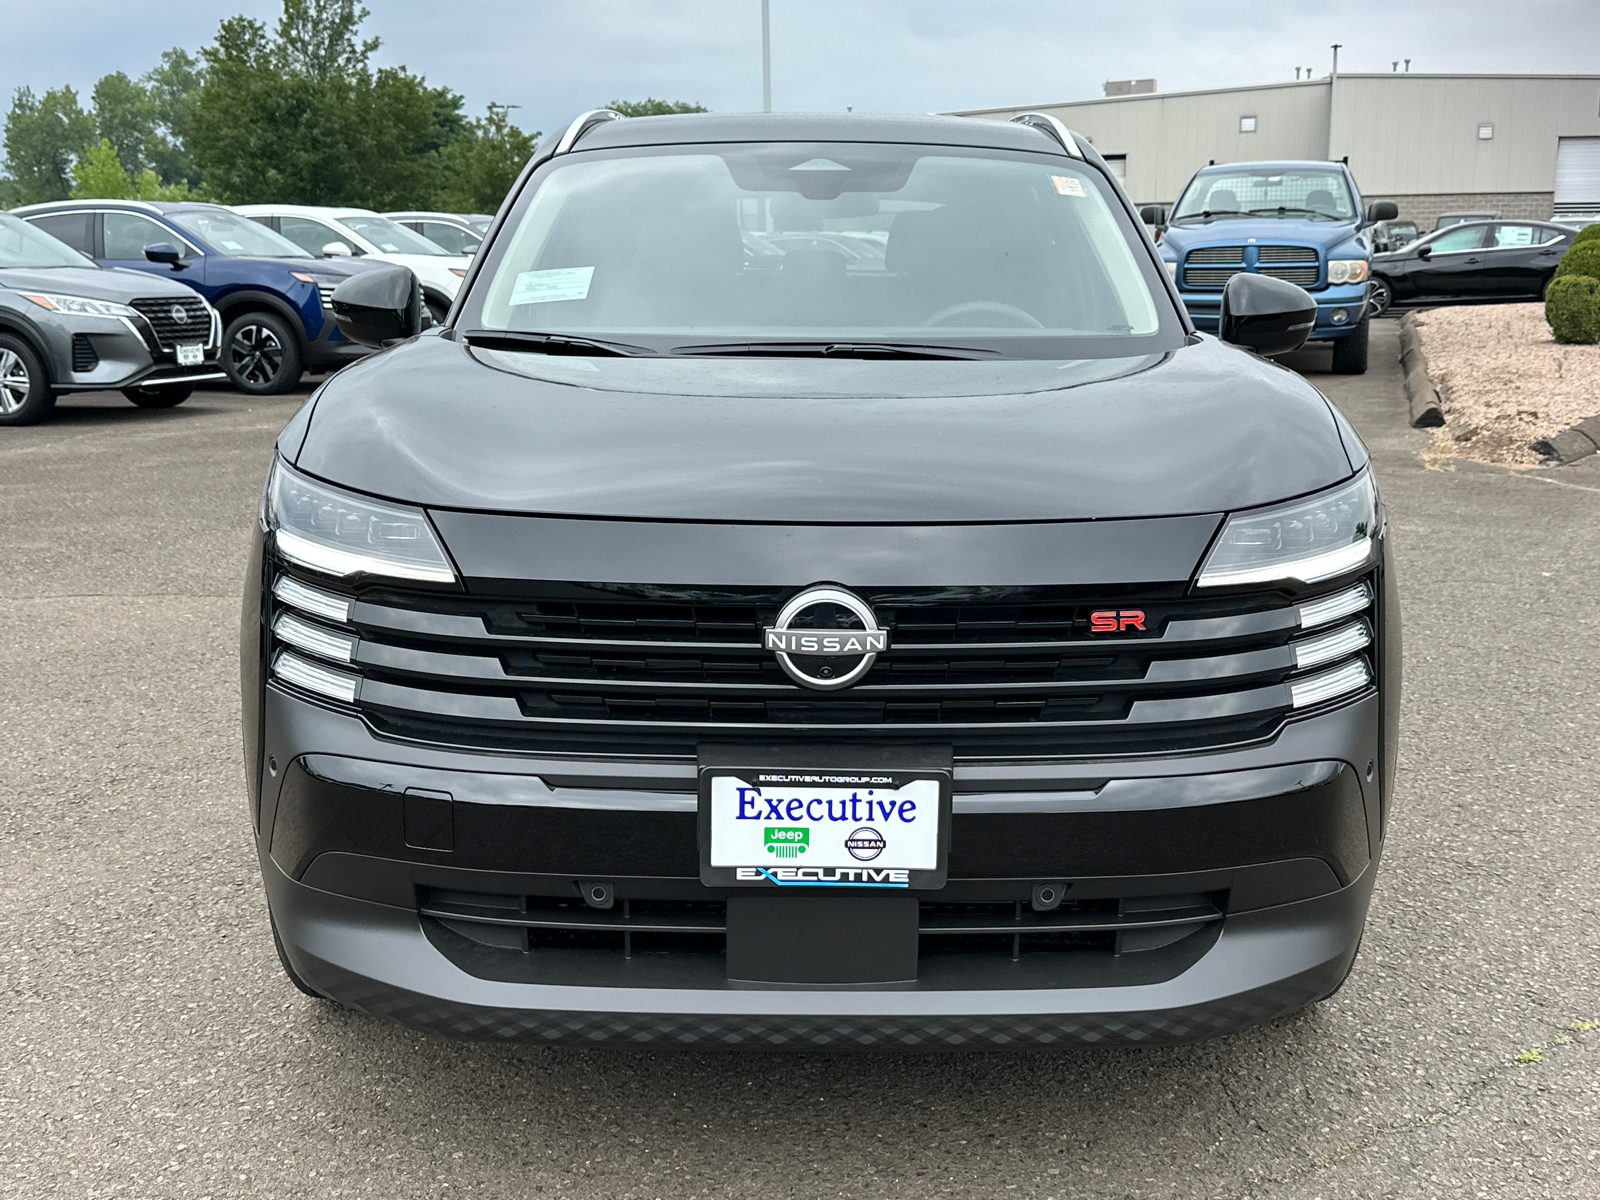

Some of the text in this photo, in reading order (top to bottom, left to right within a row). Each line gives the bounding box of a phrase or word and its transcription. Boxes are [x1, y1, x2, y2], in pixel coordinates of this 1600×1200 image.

[1091, 610, 1147, 632] SR
[768, 633, 884, 652] NISSAN
[759, 774, 893, 784] EXECUTIVEAUTOGROUP.COM
[735, 787, 917, 823] Executive
[770, 828, 804, 842] Jeep
[847, 840, 884, 848] NISSAN
[736, 867, 910, 883] EXECUTIVE
